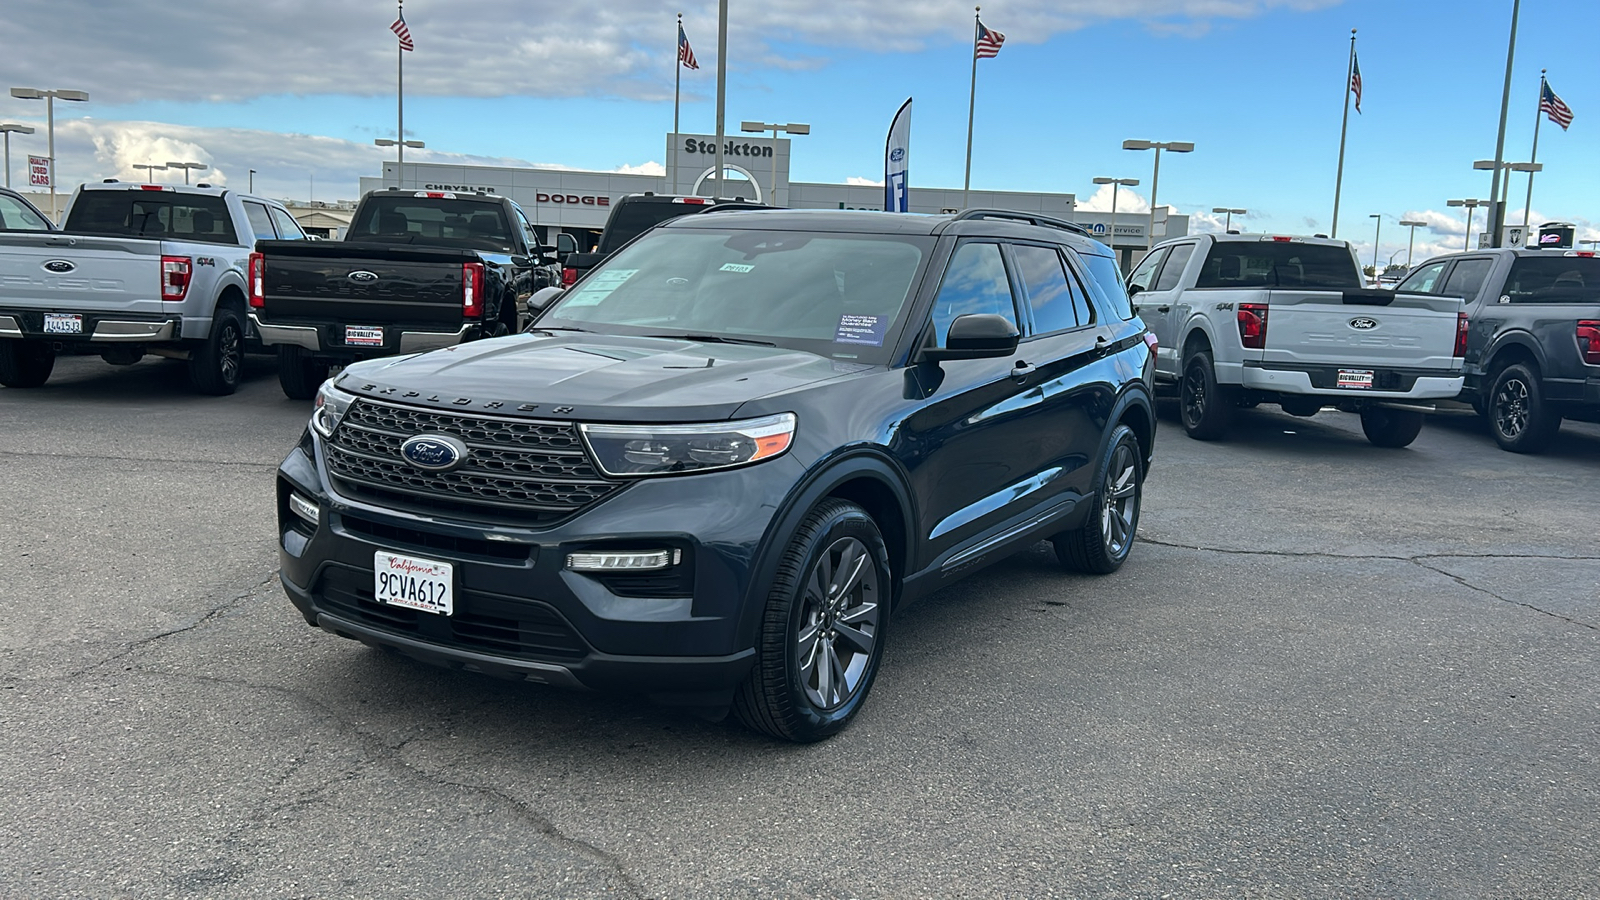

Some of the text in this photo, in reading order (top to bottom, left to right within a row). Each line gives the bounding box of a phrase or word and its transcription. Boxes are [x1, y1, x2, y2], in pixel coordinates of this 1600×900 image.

[30, 158, 49, 167] QUALITY
[32, 166, 47, 175] USED
[31, 174, 49, 185] CARS
[425, 184, 495, 193] CHRYSLER
[536, 193, 610, 206] DODGE
[1354, 319, 1373, 328] Ford
[361, 383, 574, 414] EXPLORER
[412, 442, 445, 462] Ford
[390, 557, 438, 576] California
[380, 571, 446, 607] 9CVA612
